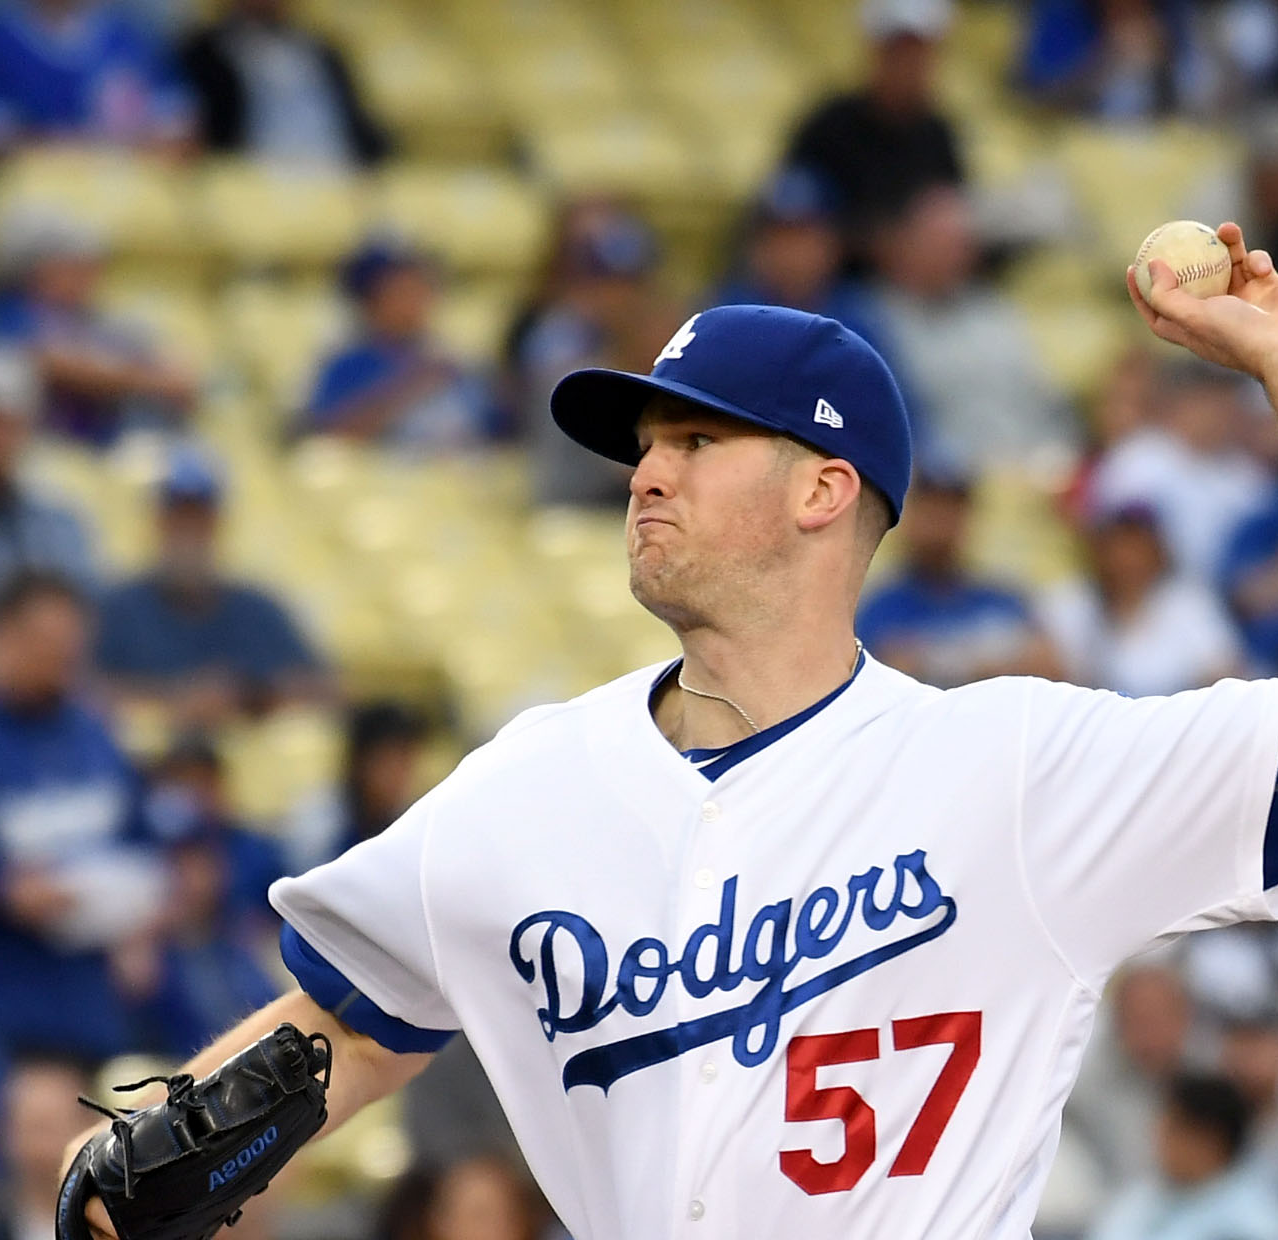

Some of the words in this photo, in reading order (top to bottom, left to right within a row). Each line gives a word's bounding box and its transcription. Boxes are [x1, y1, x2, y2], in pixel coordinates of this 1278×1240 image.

[510, 848, 957, 1092] Dodgers
[208, 1125, 279, 1193] A2000
[779, 1010, 983, 1196] 57
